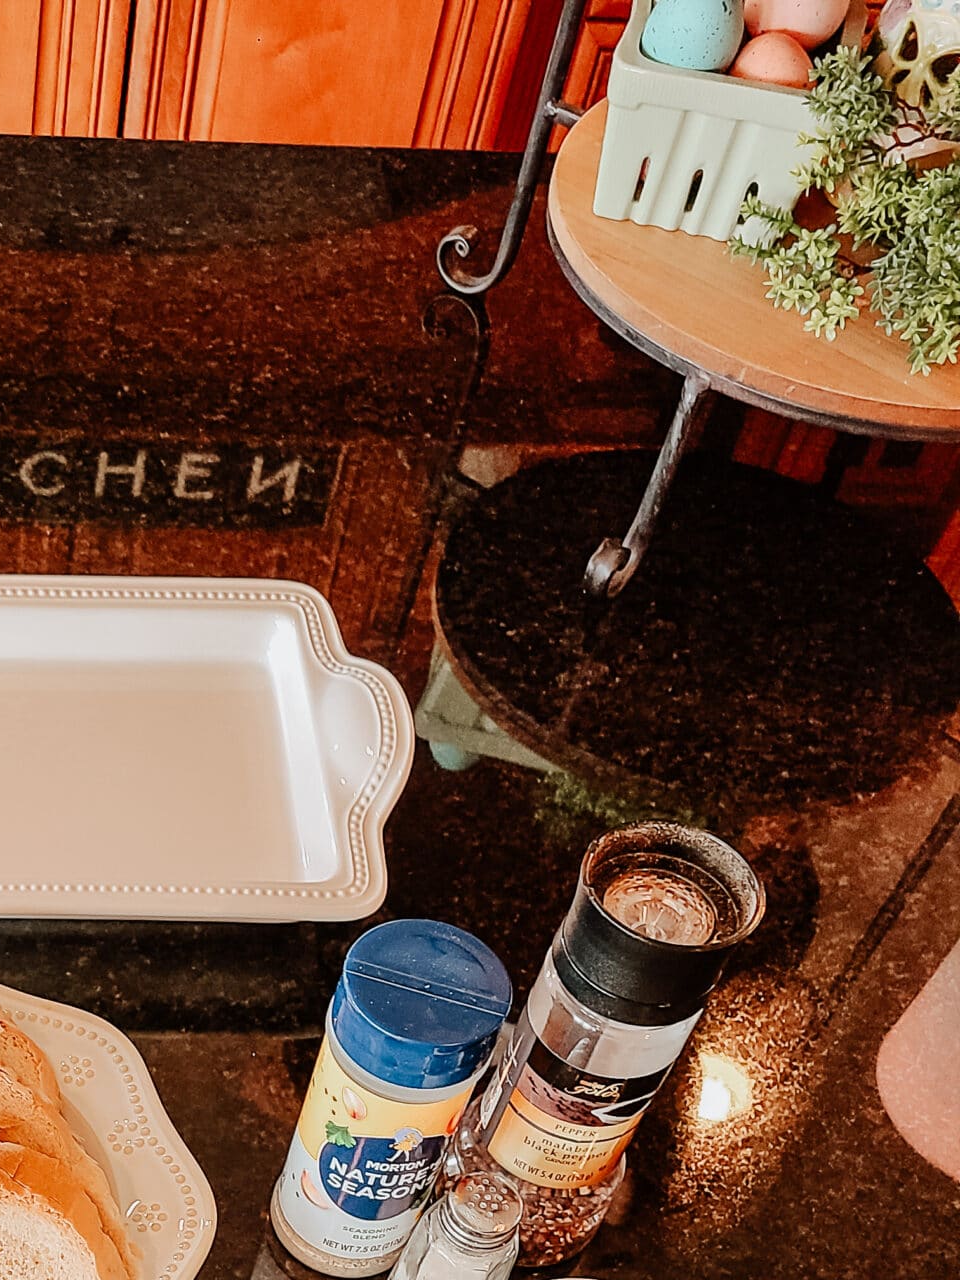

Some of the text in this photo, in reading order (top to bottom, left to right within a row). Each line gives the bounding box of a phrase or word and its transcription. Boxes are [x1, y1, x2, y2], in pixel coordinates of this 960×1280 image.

[555, 1123, 597, 1138] PEPPER
[523, 1135, 608, 1162] black pepper
[365, 1159, 426, 1173] MORTON
[513, 1157, 527, 1171] NET
[527, 1163, 540, 1176] WT
[540, 1170, 553, 1181] 5.4
[326, 1171, 436, 1201] SEASONS
[342, 1225, 399, 1235] SEASONING
[352, 1233, 387, 1241] BLEND
[322, 1238, 340, 1250] NET
[340, 1243, 355, 1253] WT
[355, 1246, 369, 1254] 7.5
[369, 1244, 382, 1253] OZ
